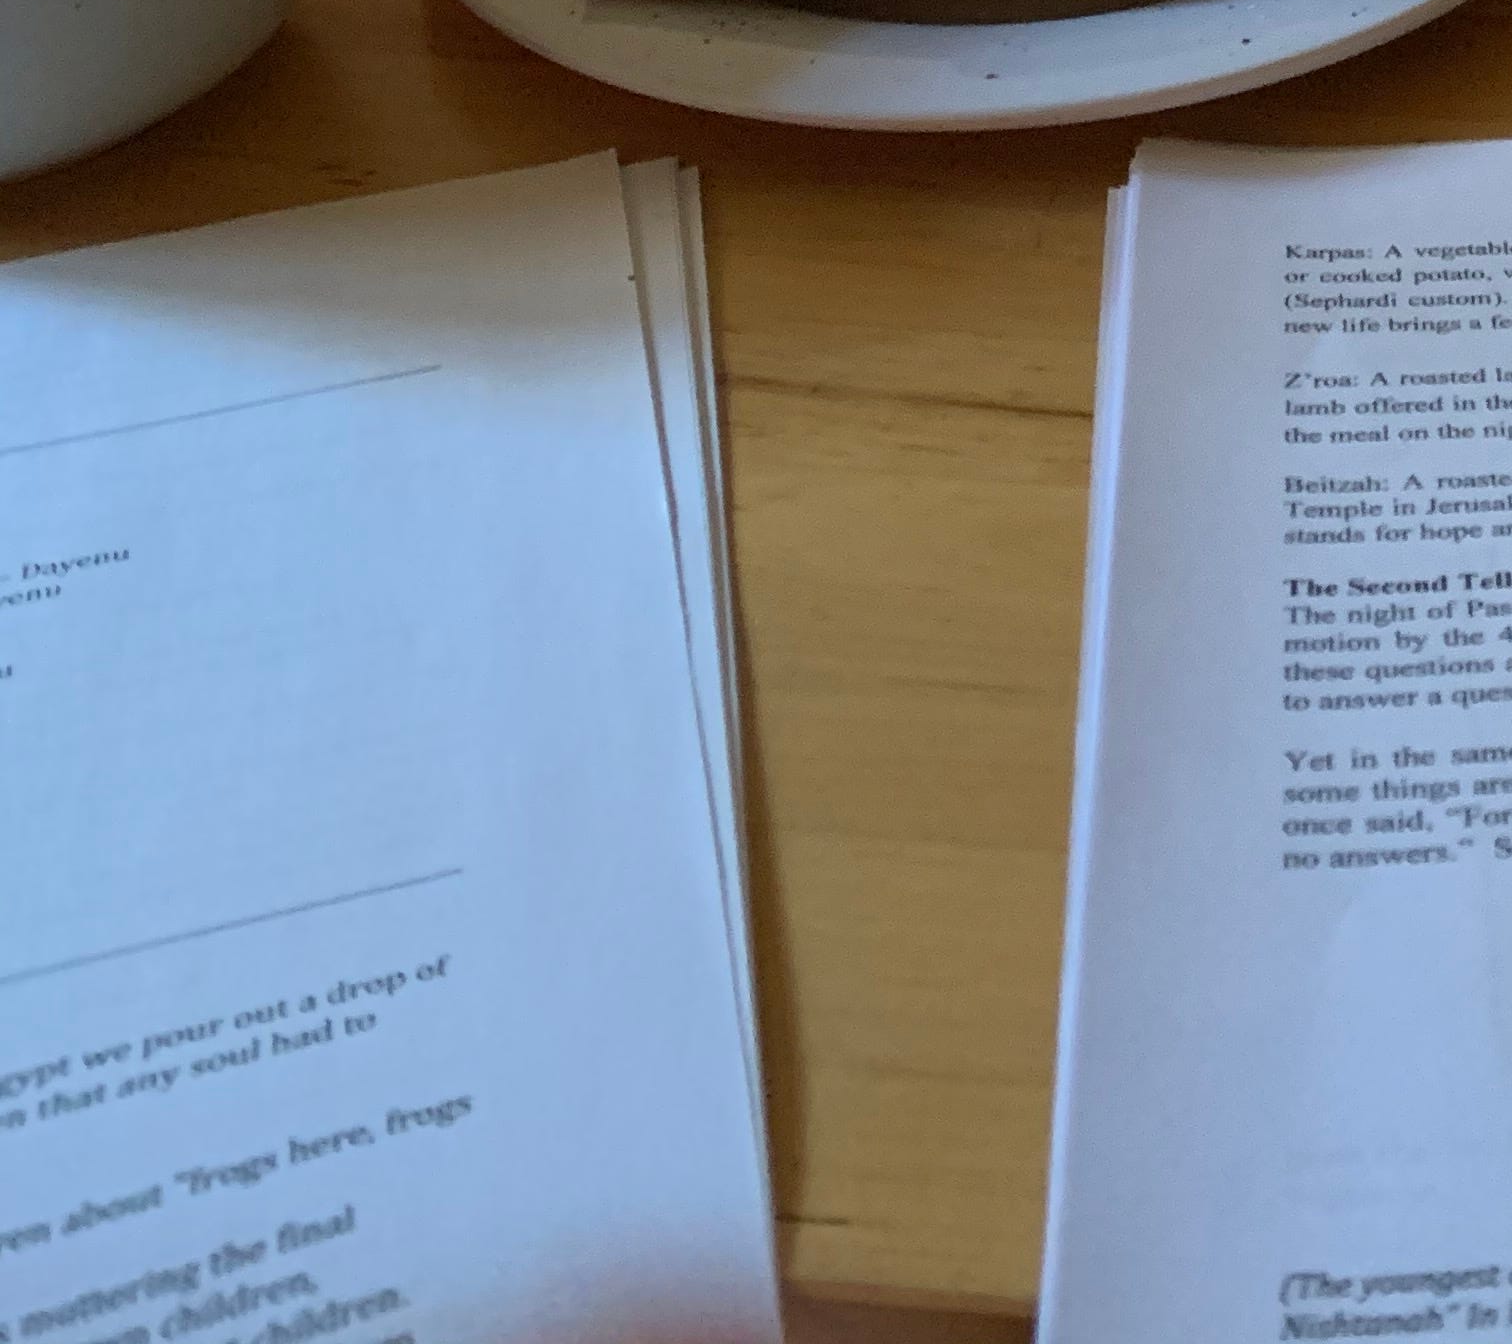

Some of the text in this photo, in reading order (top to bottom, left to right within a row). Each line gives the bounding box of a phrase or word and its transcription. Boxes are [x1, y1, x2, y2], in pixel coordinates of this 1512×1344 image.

[1286, 244, 1372, 264] Karpas:
[1384, 243, 1402, 260] A
[20, 547, 131, 582] Dayenu
[1282, 577, 1340, 598] The
[1346, 574, 1449, 597] Second
[1283, 604, 1337, 626] The
[1344, 602, 1416, 629] night
[1426, 599, 1458, 621] of
[1284, 749, 1336, 773] Yet
[1350, 746, 1379, 771] in
[1391, 744, 1437, 769] the
[1282, 849, 1322, 871] no
[1328, 837, 1475, 869] answers."
[82, 1042, 132, 1070] we
[142, 1018, 224, 1060] pour
[234, 1000, 288, 1030] out
[299, 994, 317, 1014] a
[326, 972, 407, 1006] drop
[415, 954, 449, 982] of
[37, 1083, 107, 1120] that
[116, 1066, 181, 1099] any
[190, 1037, 261, 1077] soul
[271, 1017, 334, 1056] had
[344, 1013, 376, 1036] to
